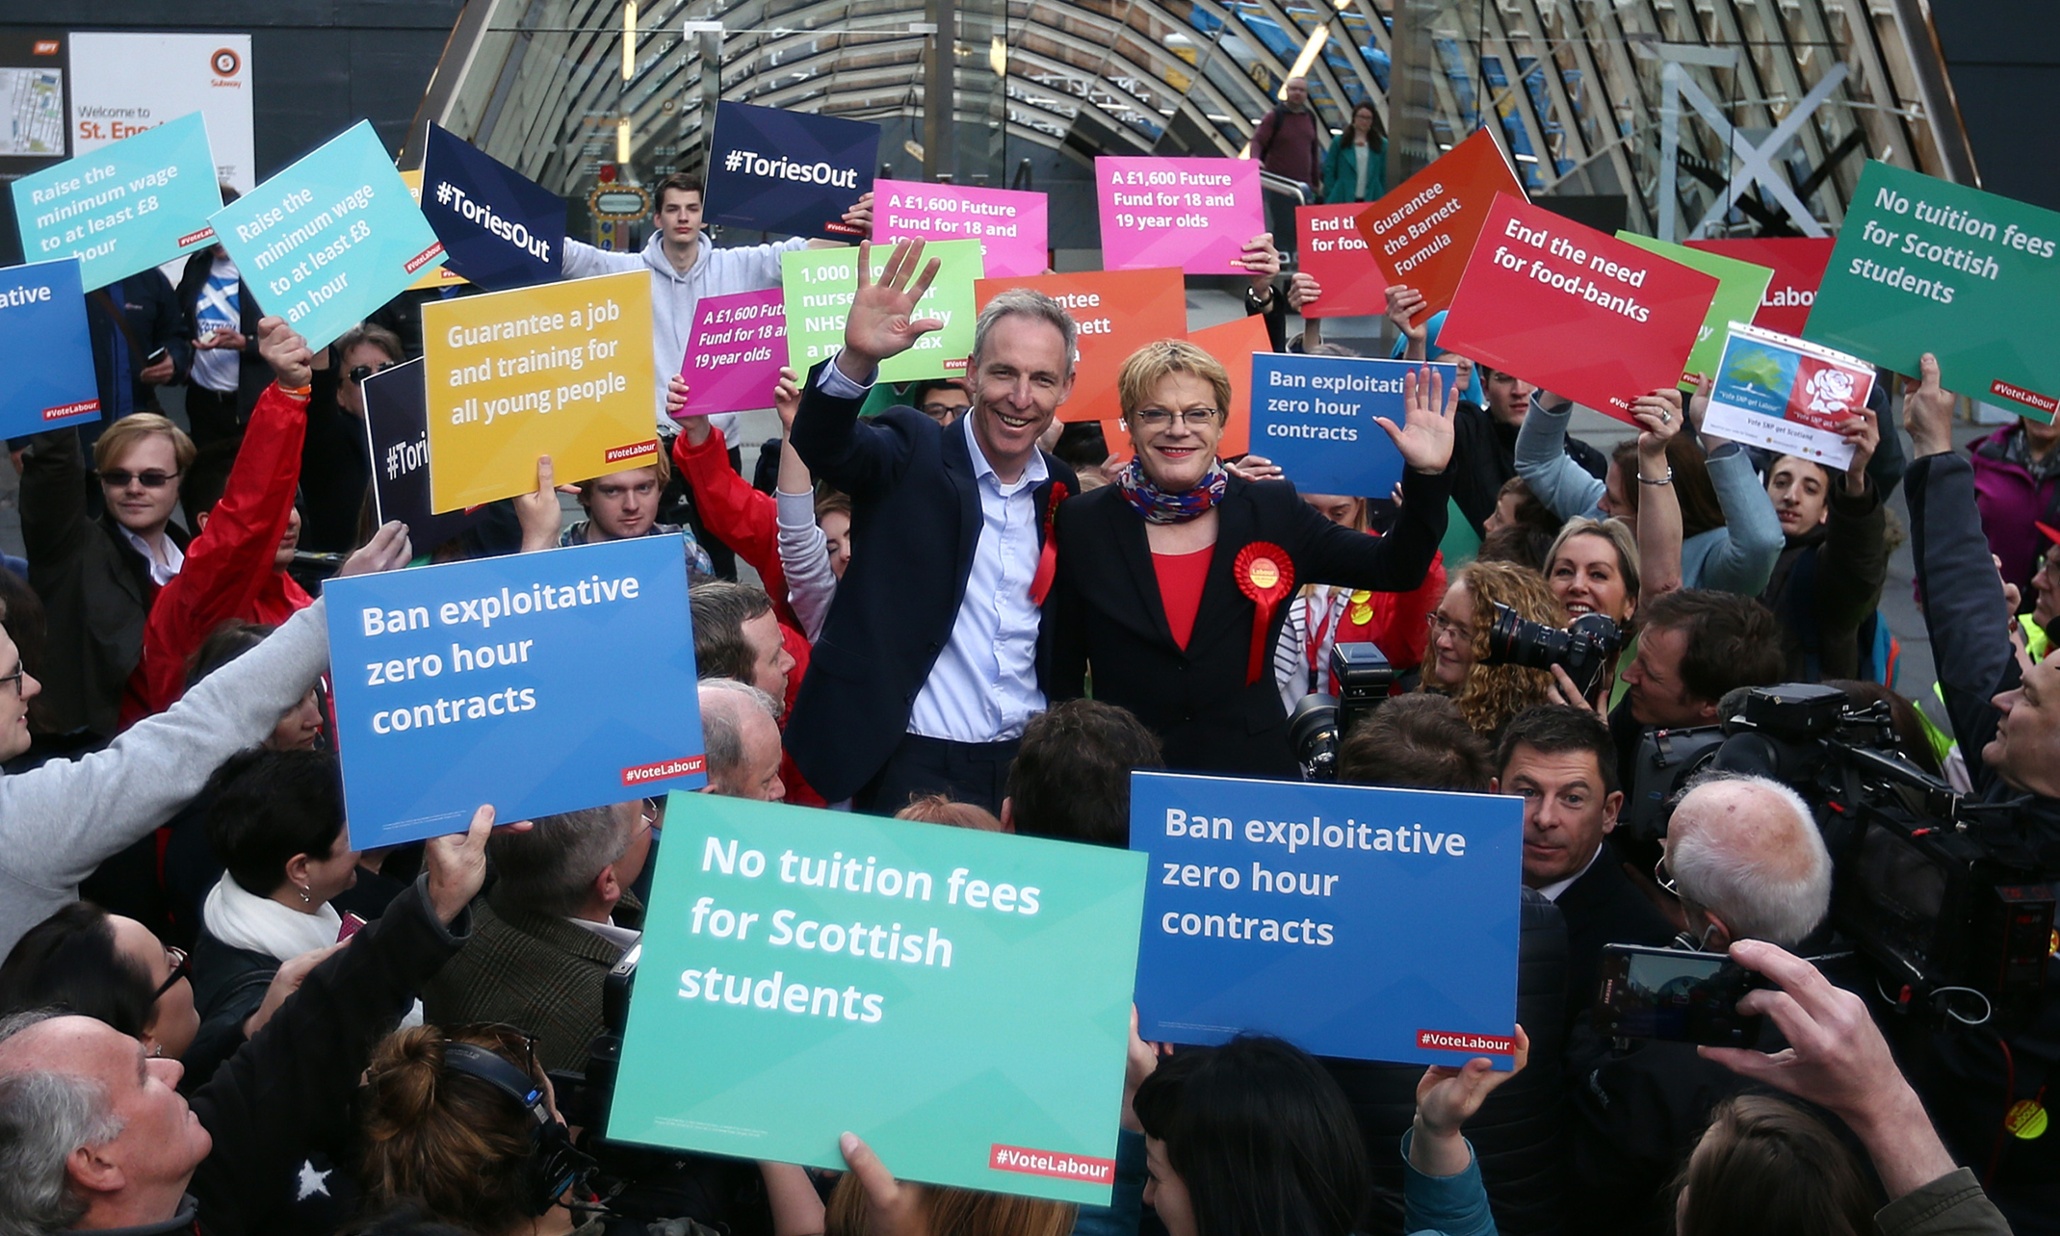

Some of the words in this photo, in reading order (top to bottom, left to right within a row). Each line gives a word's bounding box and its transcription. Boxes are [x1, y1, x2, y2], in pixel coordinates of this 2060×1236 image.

[211, 79, 241, 89] Subway
[79, 105, 135, 117] Welcome
[137, 107, 150, 117] to
[80, 121, 106, 139] St.
[32, 179, 80, 205] Raise
[84, 164, 116, 185] the
[725, 149, 858, 190] #ToriesOut
[1111, 172, 1124, 185] A
[1127, 171, 1176, 187] £1,600
[1180, 172, 1232, 186] Future
[37, 186, 125, 229] minimum
[130, 166, 178, 193] wage
[889, 194, 901, 208] A
[905, 195, 957, 213] £1,600
[961, 200, 1016, 217] Future
[1114, 192, 1153, 206] Fund
[1156, 192, 1180, 206] for
[1184, 193, 1201, 206] 18
[1205, 193, 1234, 207] and
[1373, 182, 1444, 236] Guarantee
[41, 235, 60, 252] to
[66, 225, 85, 243] at
[88, 207, 134, 234] least
[137, 196, 160, 216] £8
[236, 207, 284, 243] Raise
[282, 188, 314, 214] the
[253, 212, 333, 270] minimum
[331, 184, 375, 218] wage
[436, 181, 551, 263] #ToriesOut
[889, 215, 930, 231] Fund
[934, 217, 959, 233] for
[963, 221, 982, 235] 18
[985, 224, 1017, 238] and
[1115, 214, 1134, 227] 19
[1137, 217, 1172, 231] year
[1176, 214, 1209, 228] olds
[1311, 216, 1339, 231] End
[1383, 235, 1409, 256] the
[1408, 197, 1463, 240] Barnett
[1874, 187, 1909, 215] No
[1914, 198, 1997, 242] tuition
[2001, 225, 2056, 259] fees
[72, 238, 118, 264] hour
[180, 228, 214, 246] #VoteLab
[1312, 238, 1335, 252] for
[1862, 220, 1899, 248] for
[1900, 231, 2000, 281] Scottish
[269, 278, 291, 296] to
[291, 260, 312, 283] at
[308, 234, 351, 270] least
[350, 219, 371, 243] £8
[406, 244, 442, 271] #VoteLabour
[1394, 232, 1452, 277] Formula
[1504, 218, 1548, 249] End
[1550, 237, 1587, 265] the
[1589, 257, 1647, 289] need
[801, 265, 850, 285] 1,000
[1493, 246, 1527, 273] for
[1529, 261, 1650, 323] food-banks
[1849, 255, 1956, 305] students
[286, 302, 312, 323] an
[308, 271, 350, 308] hour
[803, 293, 856, 307] nurse
[1761, 286, 1817, 307] Labo
[448, 311, 564, 348] Guarantee
[570, 310, 582, 328] a
[586, 299, 620, 331] job
[703, 311, 713, 325] A
[715, 305, 758, 324] £1,600
[805, 315, 846, 332] NHS
[699, 328, 733, 347] Fund
[734, 328, 755, 342] for
[758, 325, 773, 339] 18
[807, 346, 818, 357] a
[449, 358, 491, 387] and
[498, 346, 583, 377] training
[588, 338, 618, 360] for
[695, 353, 709, 368] 19
[710, 352, 742, 370] year
[743, 346, 772, 362] olds
[1269, 370, 1306, 388] Ban
[1311, 374, 1404, 394] exploitati
[1994, 383, 2055, 411] #VoteLabour
[46, 401, 97, 419] #VoteLabour
[451, 398, 478, 425] all
[483, 389, 551, 426] young
[557, 372, 626, 409] people
[1268, 398, 1310, 413] zero
[1314, 398, 1361, 417] hour
[1267, 423, 1359, 441] contracts
[1747, 418, 1761, 427] Vote
[1762, 421, 1775, 430] SNP
[1775, 425, 1786, 434] get
[1787, 428, 1814, 441] Scotland
[387, 430, 428, 481] #Tori
[607, 442, 656, 461] #VoteLabour
[362, 605, 430, 637] Ban
[439, 574, 640, 628] exploitative
[366, 653, 443, 687] zero
[452, 638, 533, 674] hour
[372, 685, 537, 735] contracts
[626, 758, 702, 782] #VoteLabour
[1165, 808, 1233, 840] Ban
[1244, 816, 1466, 856] exploitative
[701, 836, 767, 879] No
[779, 847, 934, 901] tuition
[947, 868, 1041, 916] fees
[1162, 861, 1241, 889] zero
[1252, 861, 1339, 896] hour
[691, 896, 759, 940] for
[768, 908, 954, 968] Scottish
[1161, 910, 1334, 946] contracts
[678, 966, 885, 1023] students
[1421, 1033, 1510, 1052] #VoteLabour
[996, 1148, 1109, 1179] #VoteLabour
